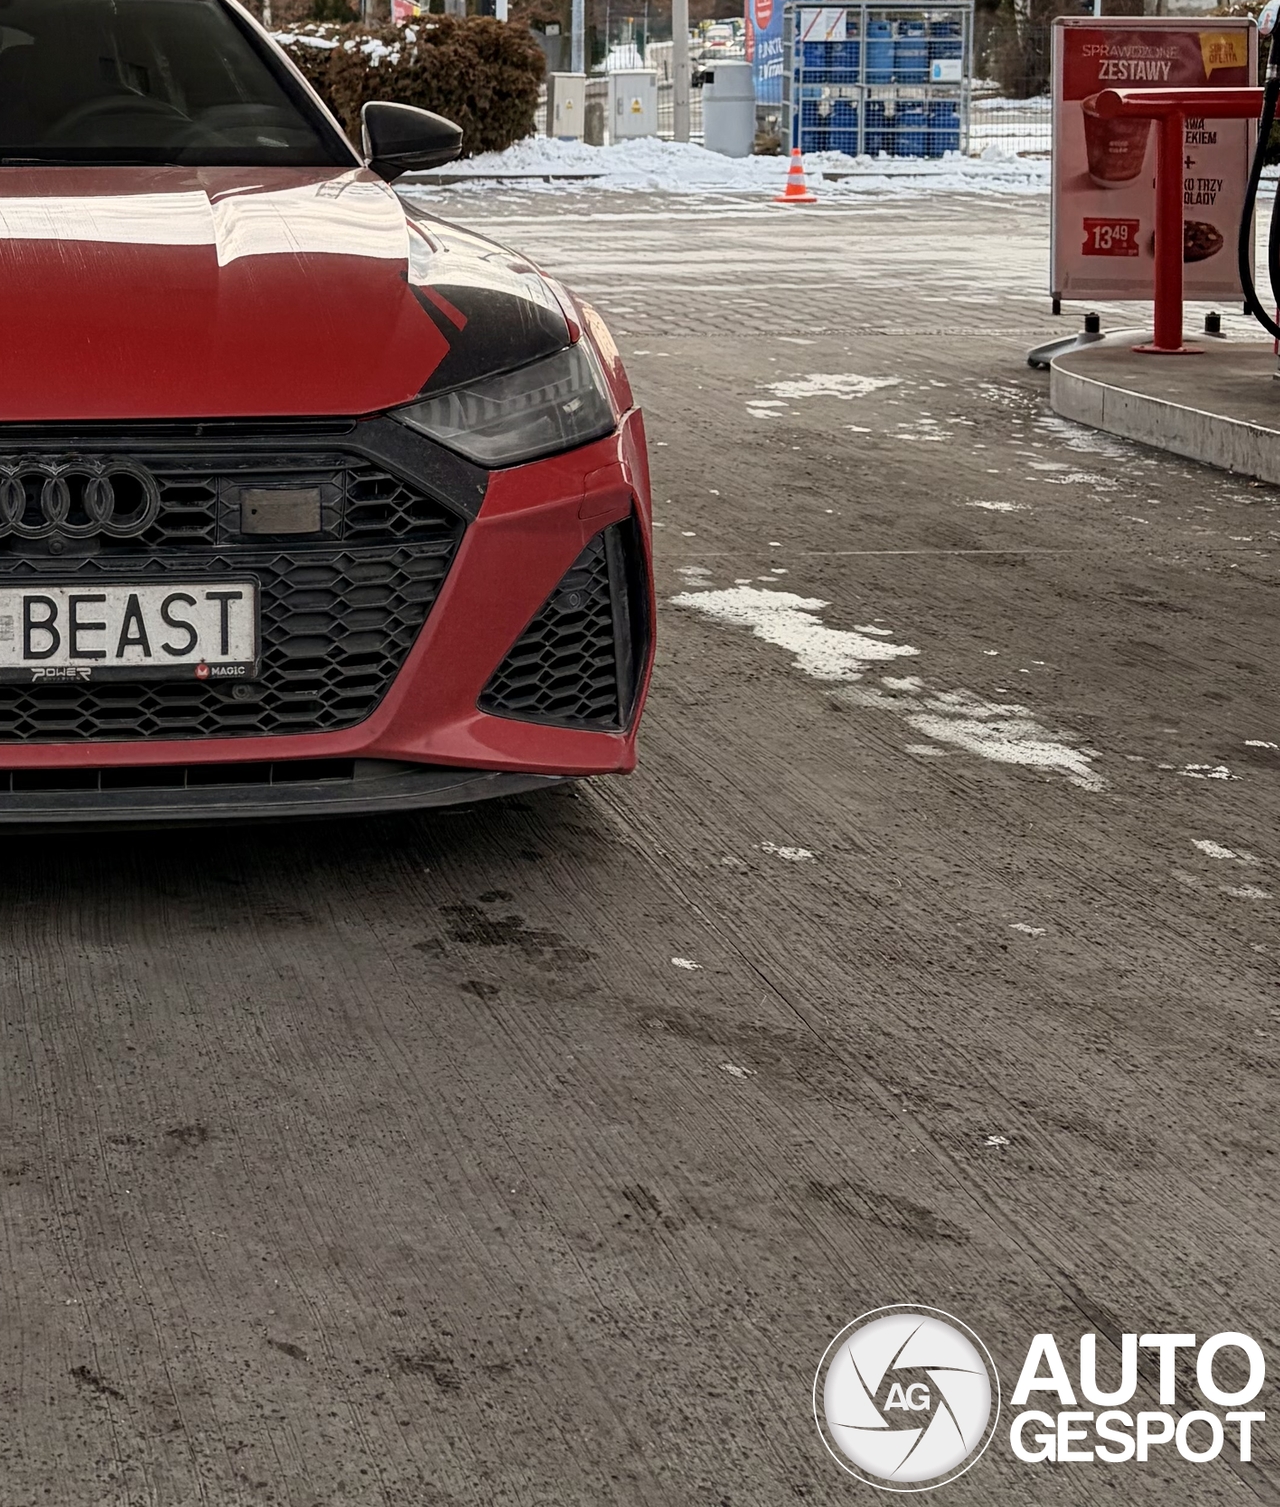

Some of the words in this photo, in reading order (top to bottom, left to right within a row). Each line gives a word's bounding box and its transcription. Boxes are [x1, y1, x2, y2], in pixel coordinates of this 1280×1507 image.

[1098, 59, 1172, 81] ZESTAWY
[1197, 178, 1223, 192] TRZY
[23, 591, 243, 660] BEAST
[31, 667, 92, 682] POWER
[211, 666, 246, 677] MAGIC
